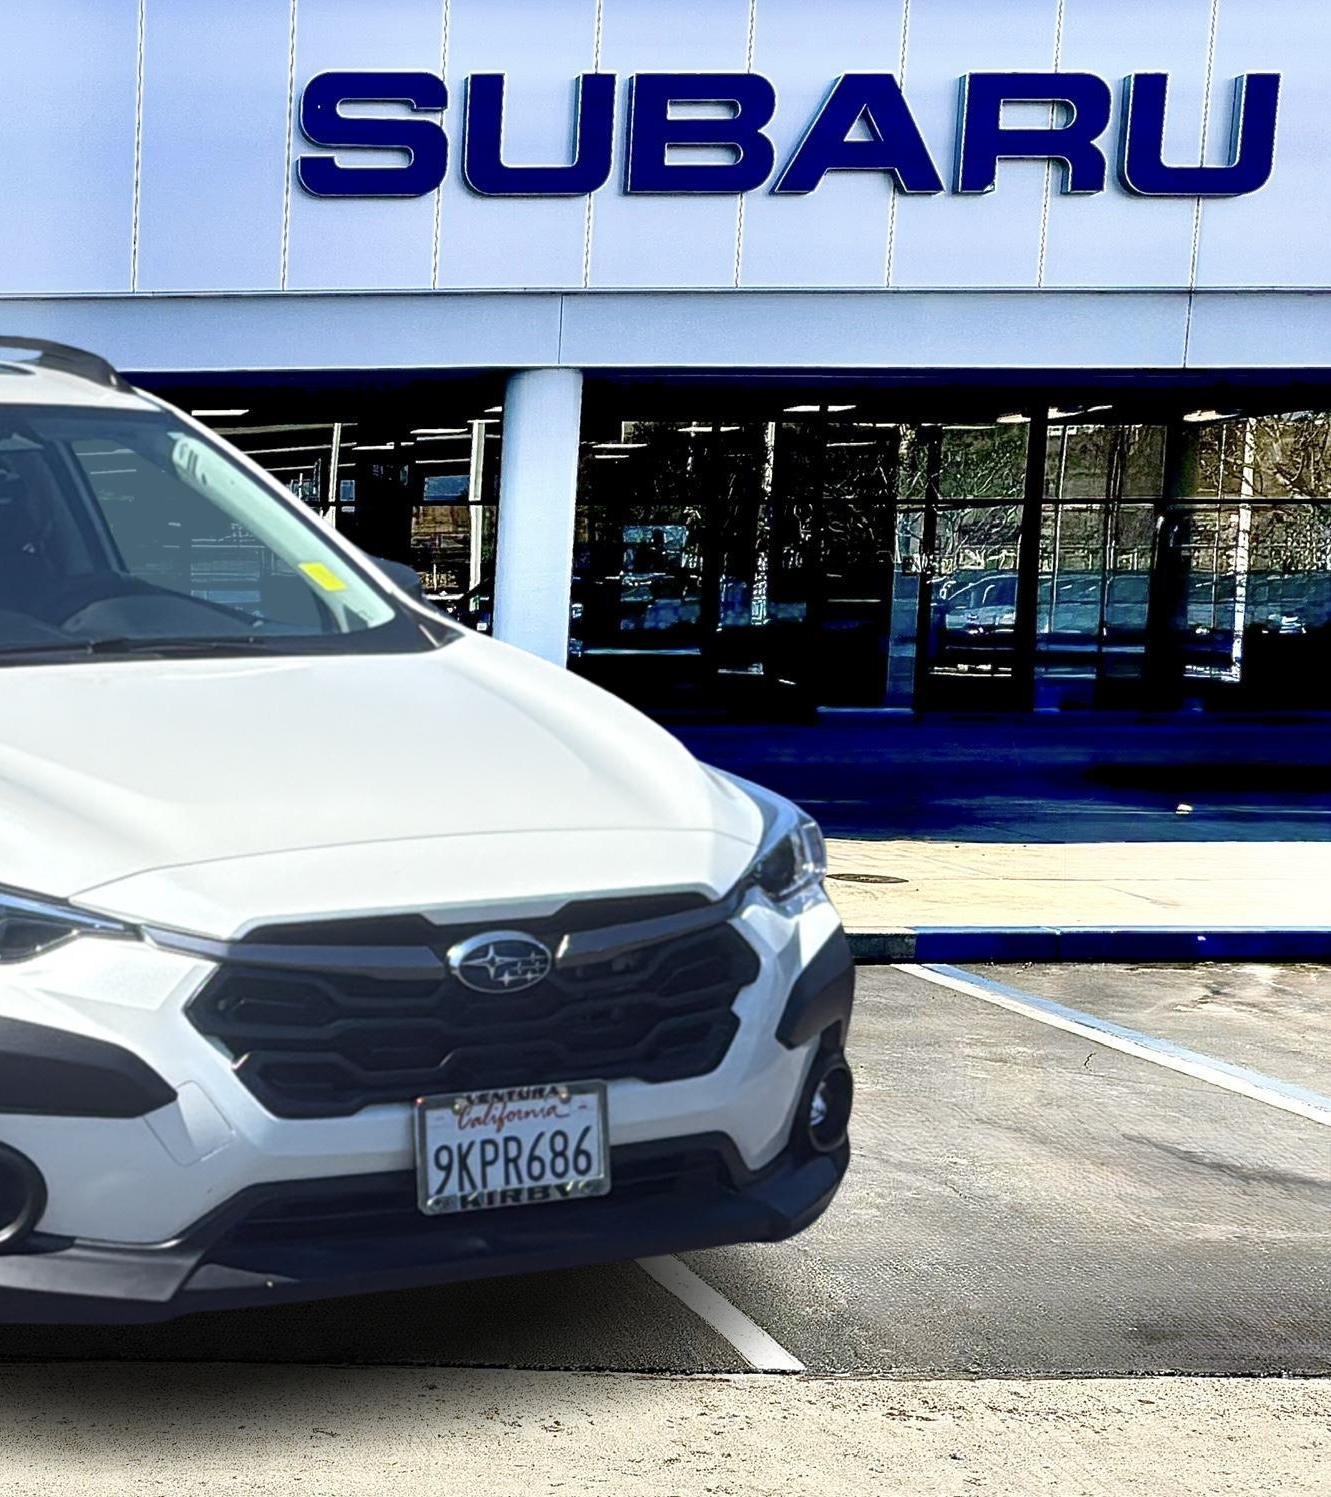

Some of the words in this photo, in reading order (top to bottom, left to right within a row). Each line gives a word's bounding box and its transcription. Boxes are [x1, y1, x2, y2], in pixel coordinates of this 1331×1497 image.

[294, 70, 1283, 198] SUBARU
[465, 1085, 559, 1104] VENTURA
[457, 1101, 570, 1133] California
[433, 1125, 592, 1195] 9KPR686
[459, 1184, 573, 1209] KIRBY
